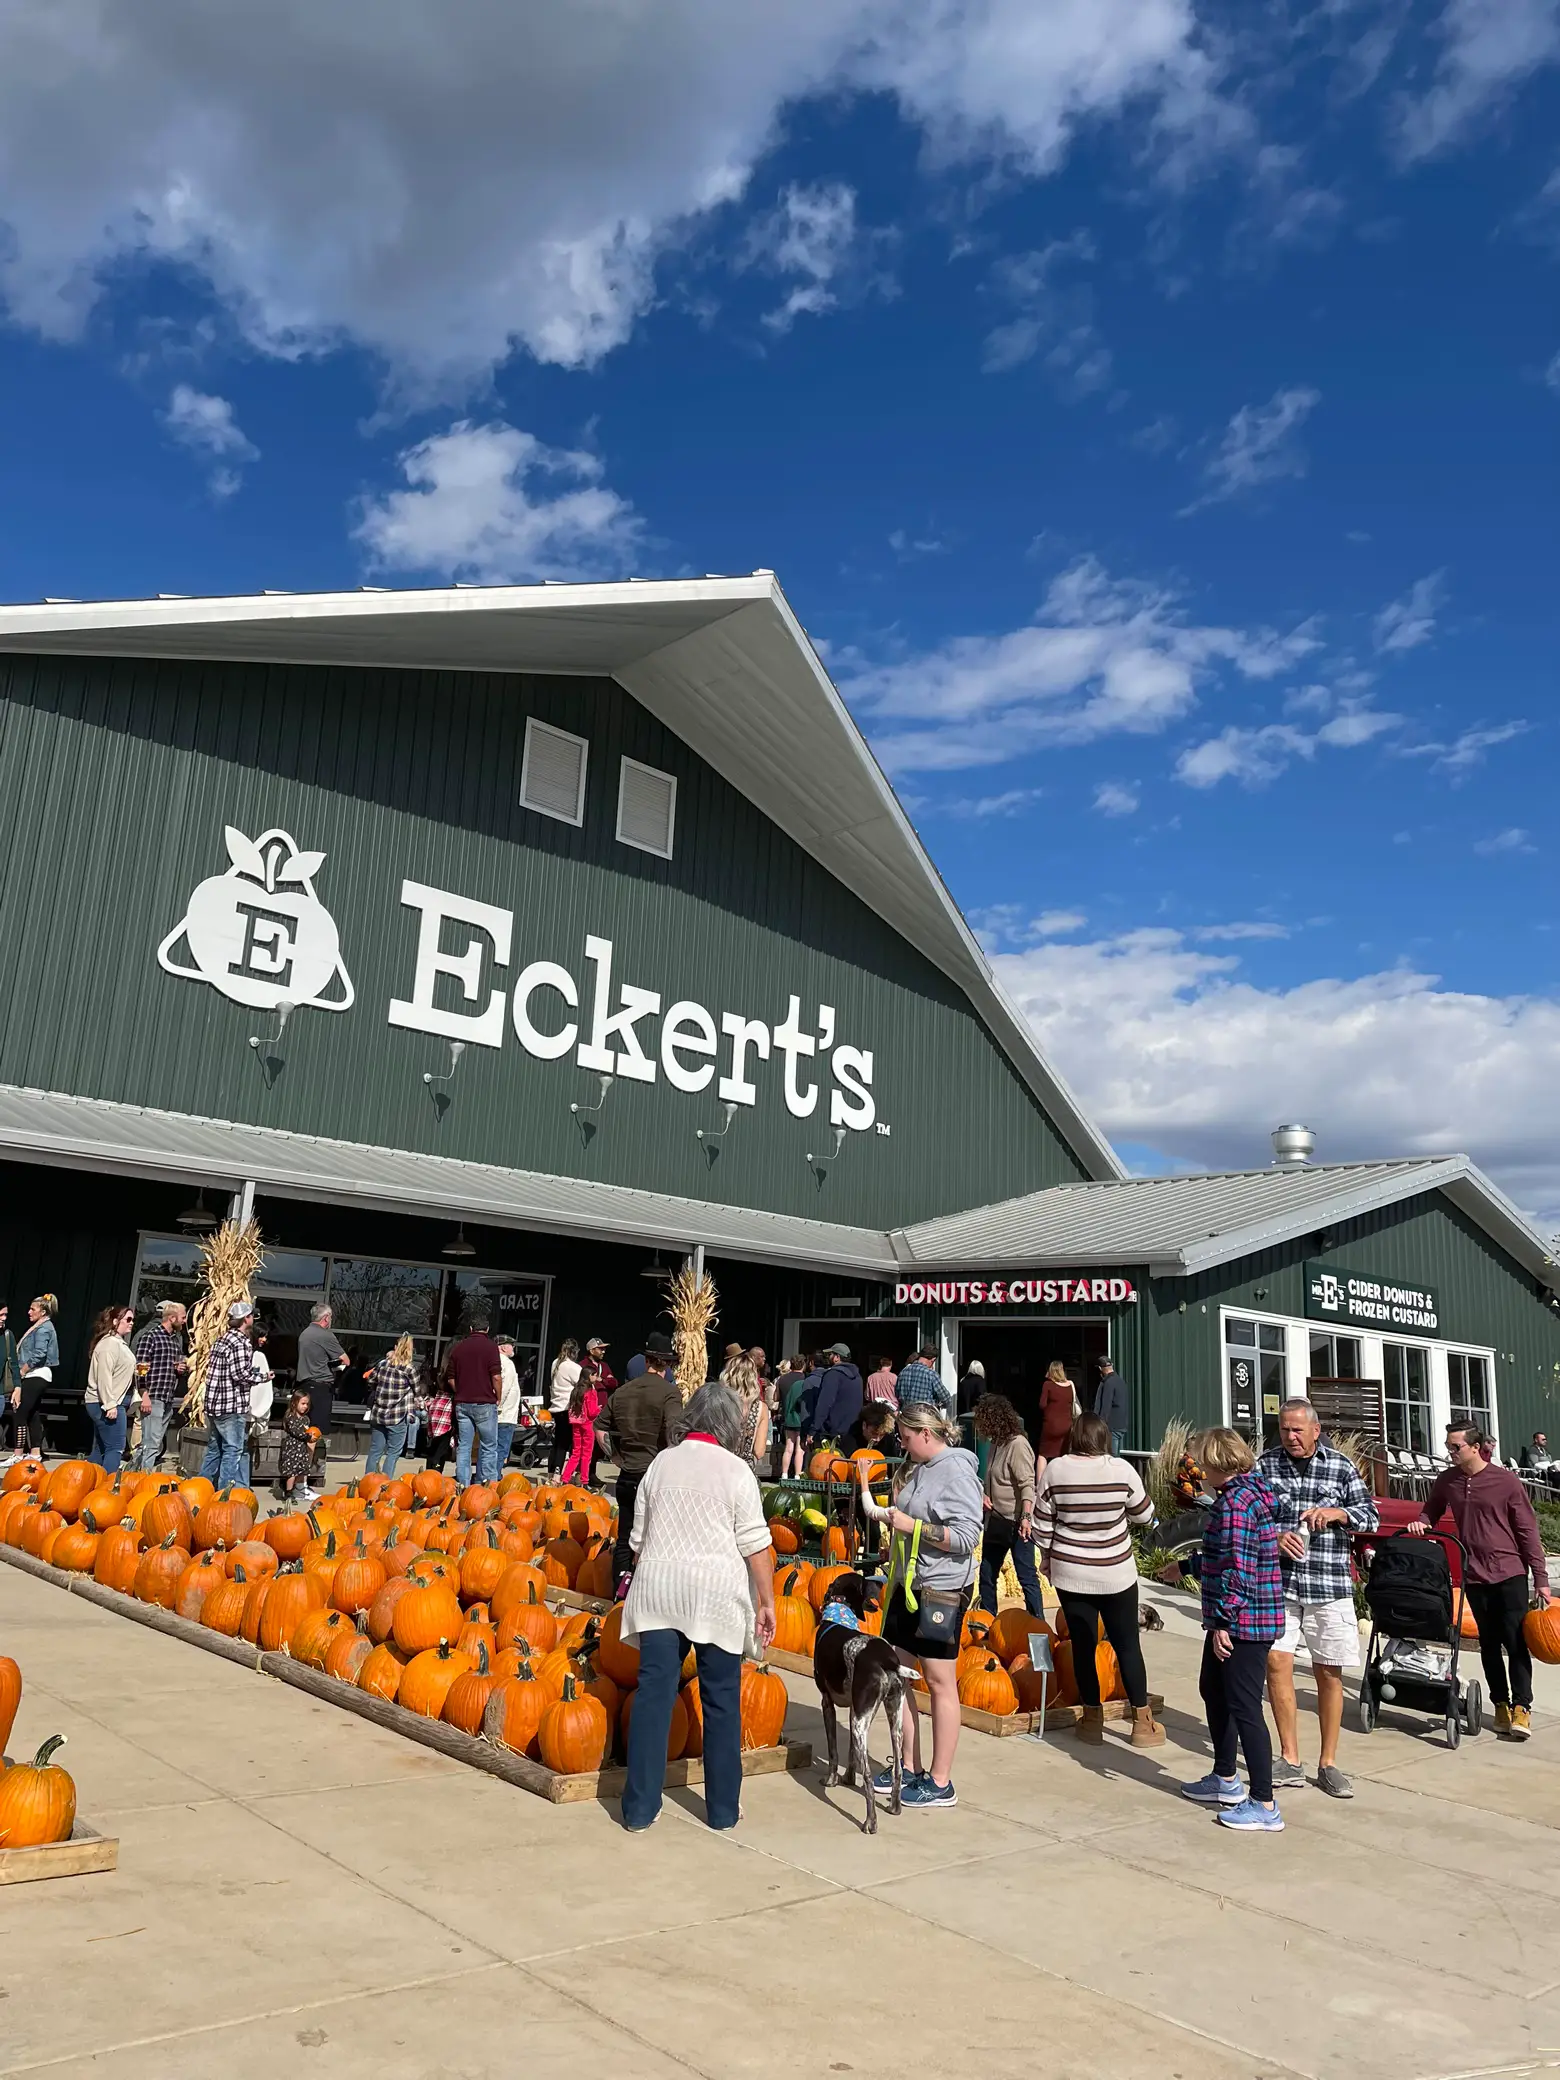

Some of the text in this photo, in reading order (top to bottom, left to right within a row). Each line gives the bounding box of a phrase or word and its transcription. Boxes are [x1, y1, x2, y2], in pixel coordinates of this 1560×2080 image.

[229, 902, 300, 988] E
[388, 879, 876, 1132] Eckert's
[895, 1278, 1127, 1304] DONUTS & CUSTARD
[1347, 1278, 1433, 1310] CIDER DONUTS &
[1348, 1298, 1438, 1329] FROZEN CUSTARD
